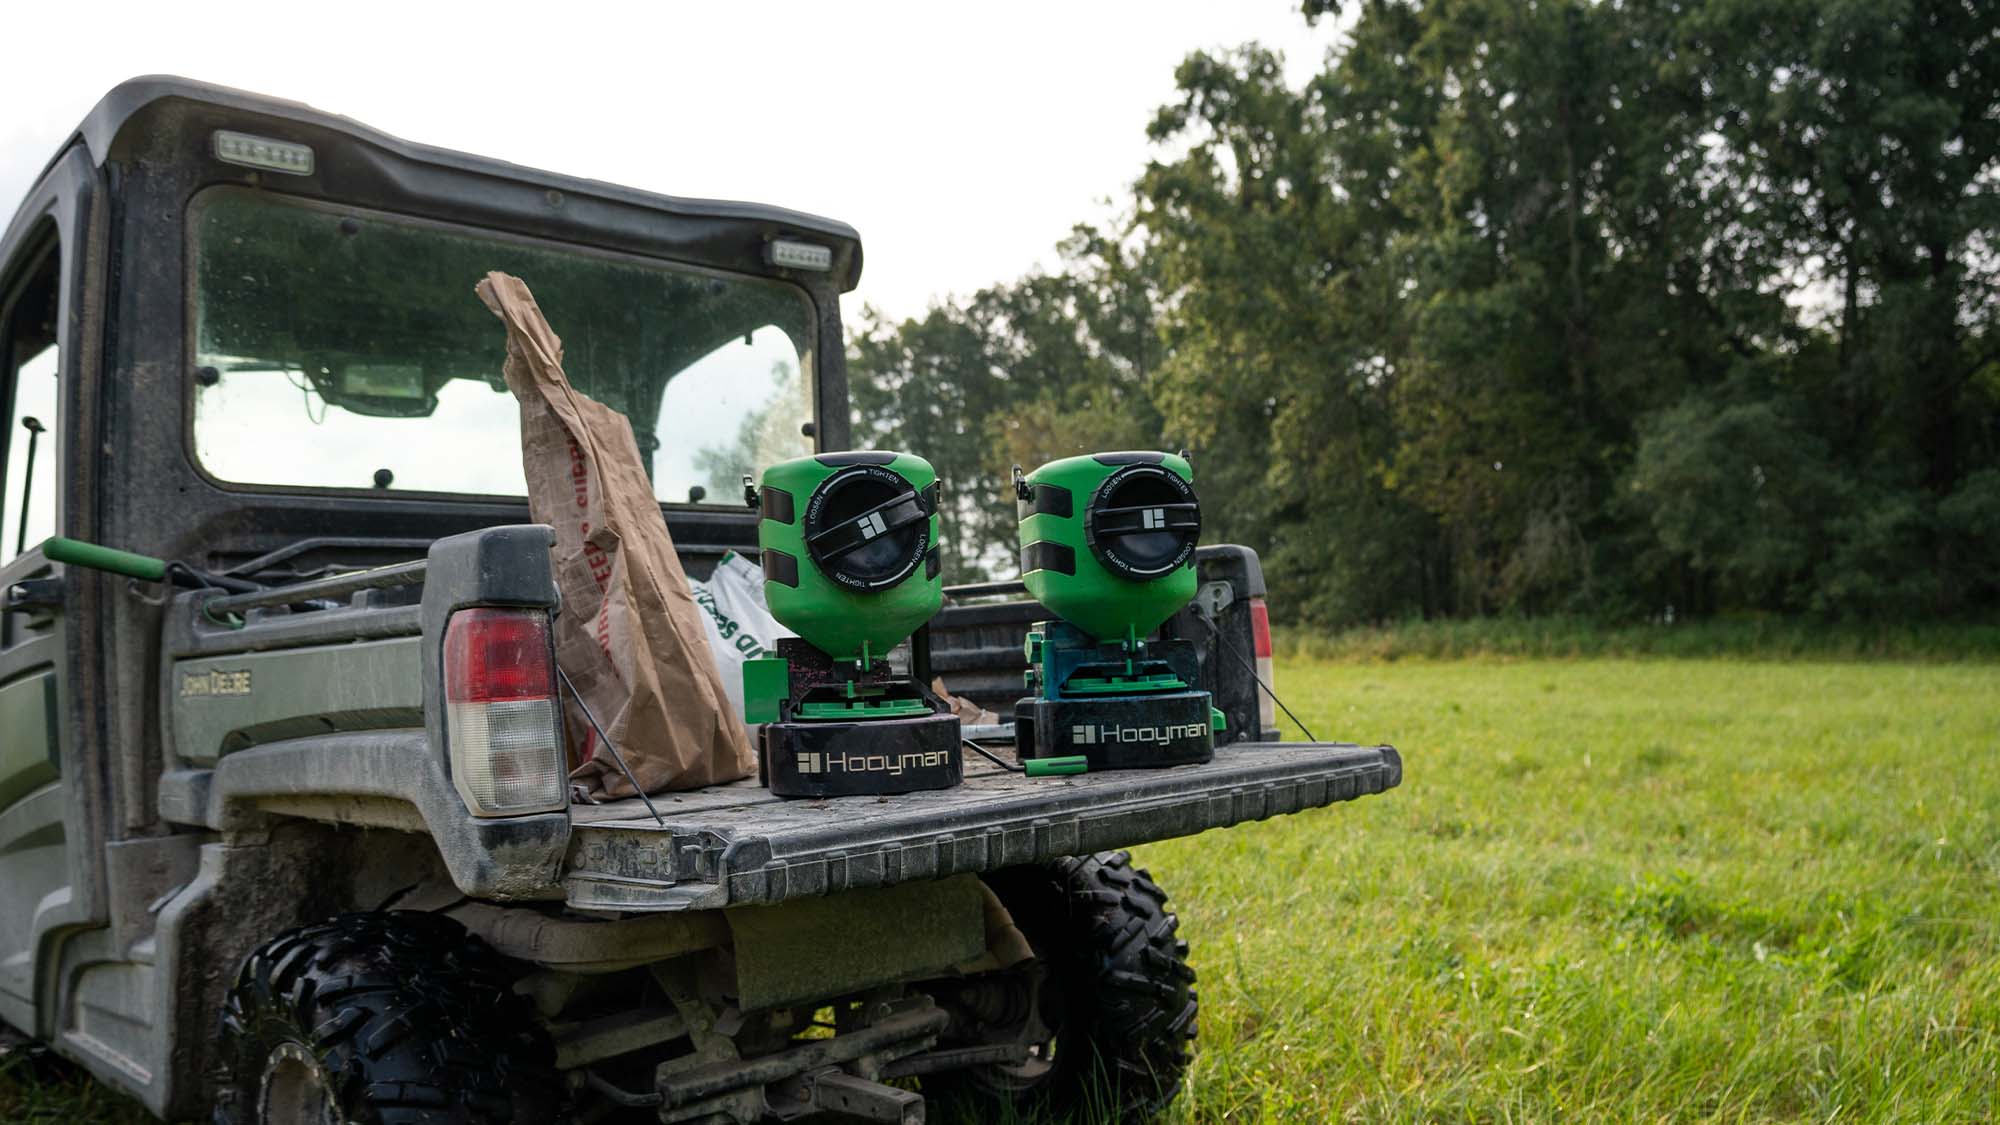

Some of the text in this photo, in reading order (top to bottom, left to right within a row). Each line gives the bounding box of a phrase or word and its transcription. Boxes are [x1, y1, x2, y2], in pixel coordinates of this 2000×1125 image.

[869, 468, 899, 485] TIGHTEN
[1102, 475, 1122, 499] LOOSEN
[1167, 472, 1190, 495] TIGHTEN
[810, 495, 823, 525] LOOSEN
[911, 534, 926, 563] LOOSEN
[1106, 549, 1129, 571] TIGHTEN
[1174, 542, 1193, 565] LOOSEN
[836, 572, 866, 588] TIGHTEN
[211, 671, 251, 695] DEERE
[1101, 722, 1207, 746] Hooyman
[826, 750, 949, 776] Hooyman
